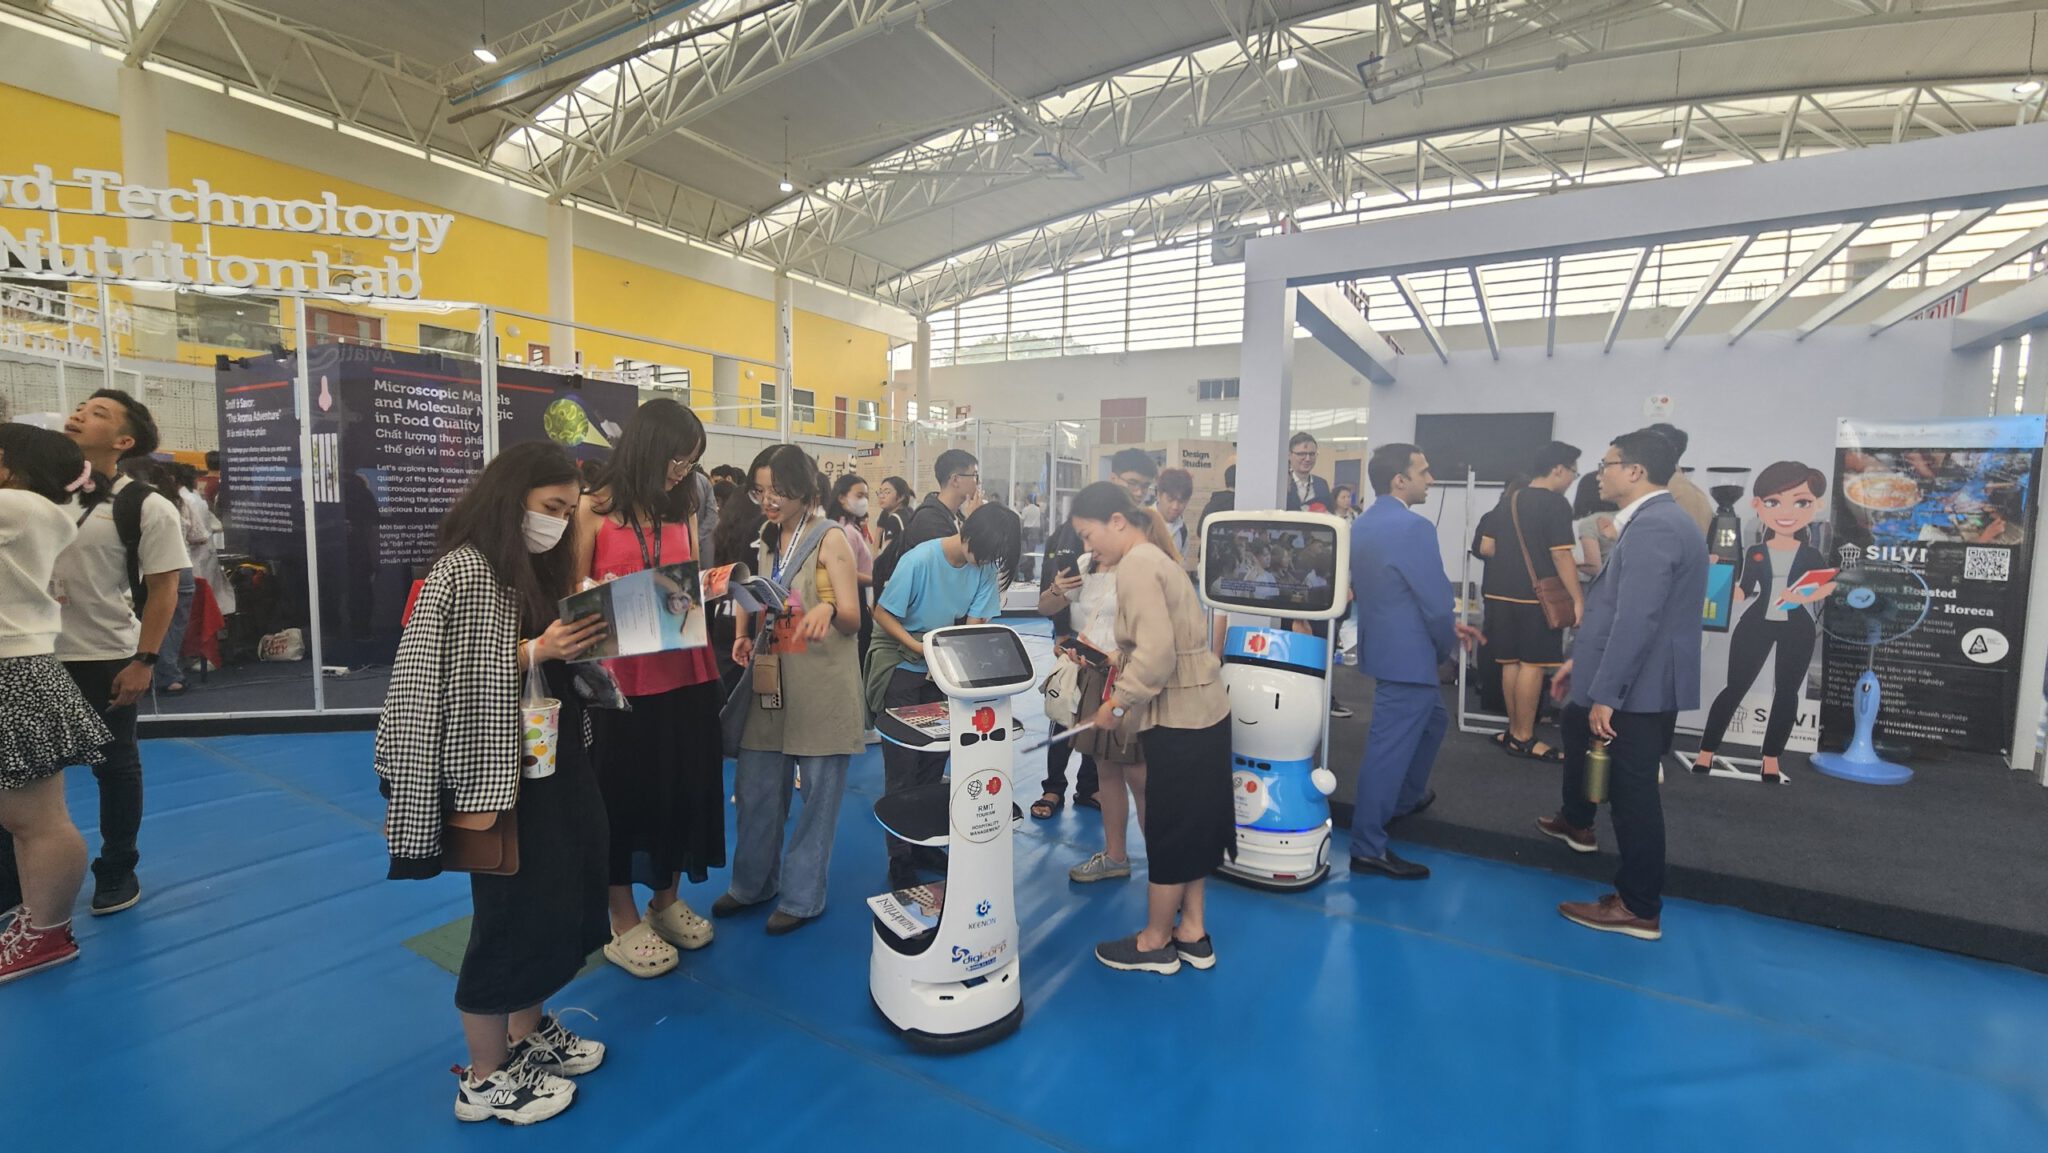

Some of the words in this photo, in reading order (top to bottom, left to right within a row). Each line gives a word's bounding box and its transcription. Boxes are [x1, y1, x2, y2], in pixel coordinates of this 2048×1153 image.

[0, 164, 57, 211] d
[73, 168, 454, 253] Technology
[0, 226, 309, 292] Nutrition
[312, 250, 422, 299] Lab
[374, 379, 459, 400] Microscopic
[462, 390, 511, 405] Maels
[374, 397, 403, 409] and
[406, 398, 474, 416] Molecular
[476, 406, 514, 421] Mgic
[375, 411, 390, 423] in
[393, 413, 430, 427] Food
[432, 417, 480, 433] Quality
[405, 431, 437, 444] lượng
[439, 433, 462, 445] thực
[1183, 449, 1210, 459] Design
[440, 466, 464, 474] hidden
[1182, 459, 1212, 468] Studies
[377, 475, 403, 483] quality
[378, 496, 415, 504] unlocking
[1866, 545, 1928, 563] SILVI
[1903, 585, 1957, 599] Roasted
[1944, 603, 1994, 617] Horeca
[1754, 708, 1816, 728] SVI
[978, 803, 994, 812] RMIT
[970, 825, 1000, 836] MANAGEMENT
[968, 917, 996, 930] KEENON
